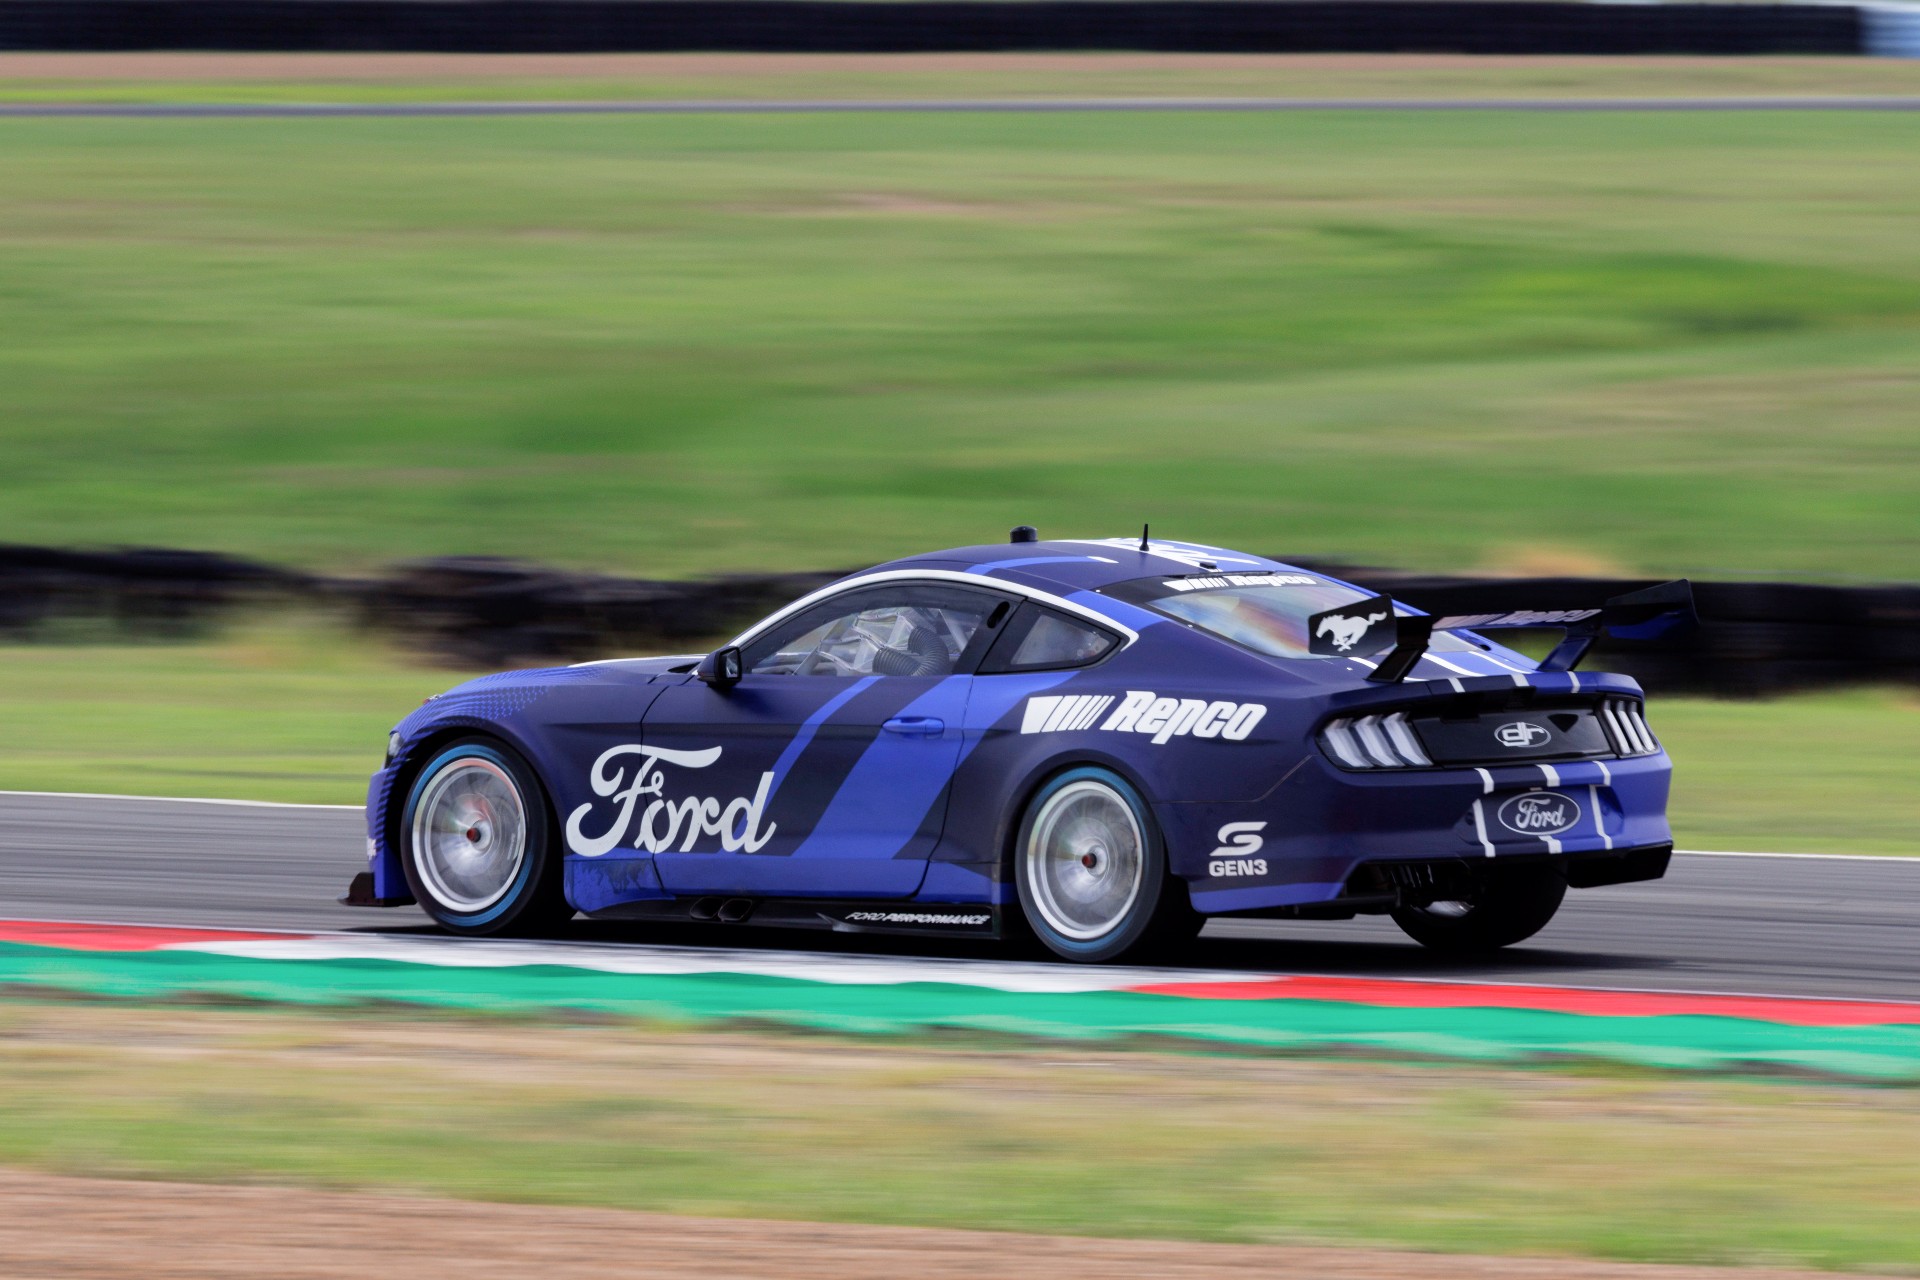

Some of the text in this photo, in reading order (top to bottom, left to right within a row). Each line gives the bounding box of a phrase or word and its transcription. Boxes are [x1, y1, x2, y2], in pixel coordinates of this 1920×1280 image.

[1486, 609, 1602, 625] Repco
[1100, 691, 1267, 744] Repco
[566, 744, 777, 857] Ford
[1515, 798, 1566, 828] Ford
[1208, 859, 1268, 877] GEN3
[845, 911, 990, 924] FORD PERFORMANCE
